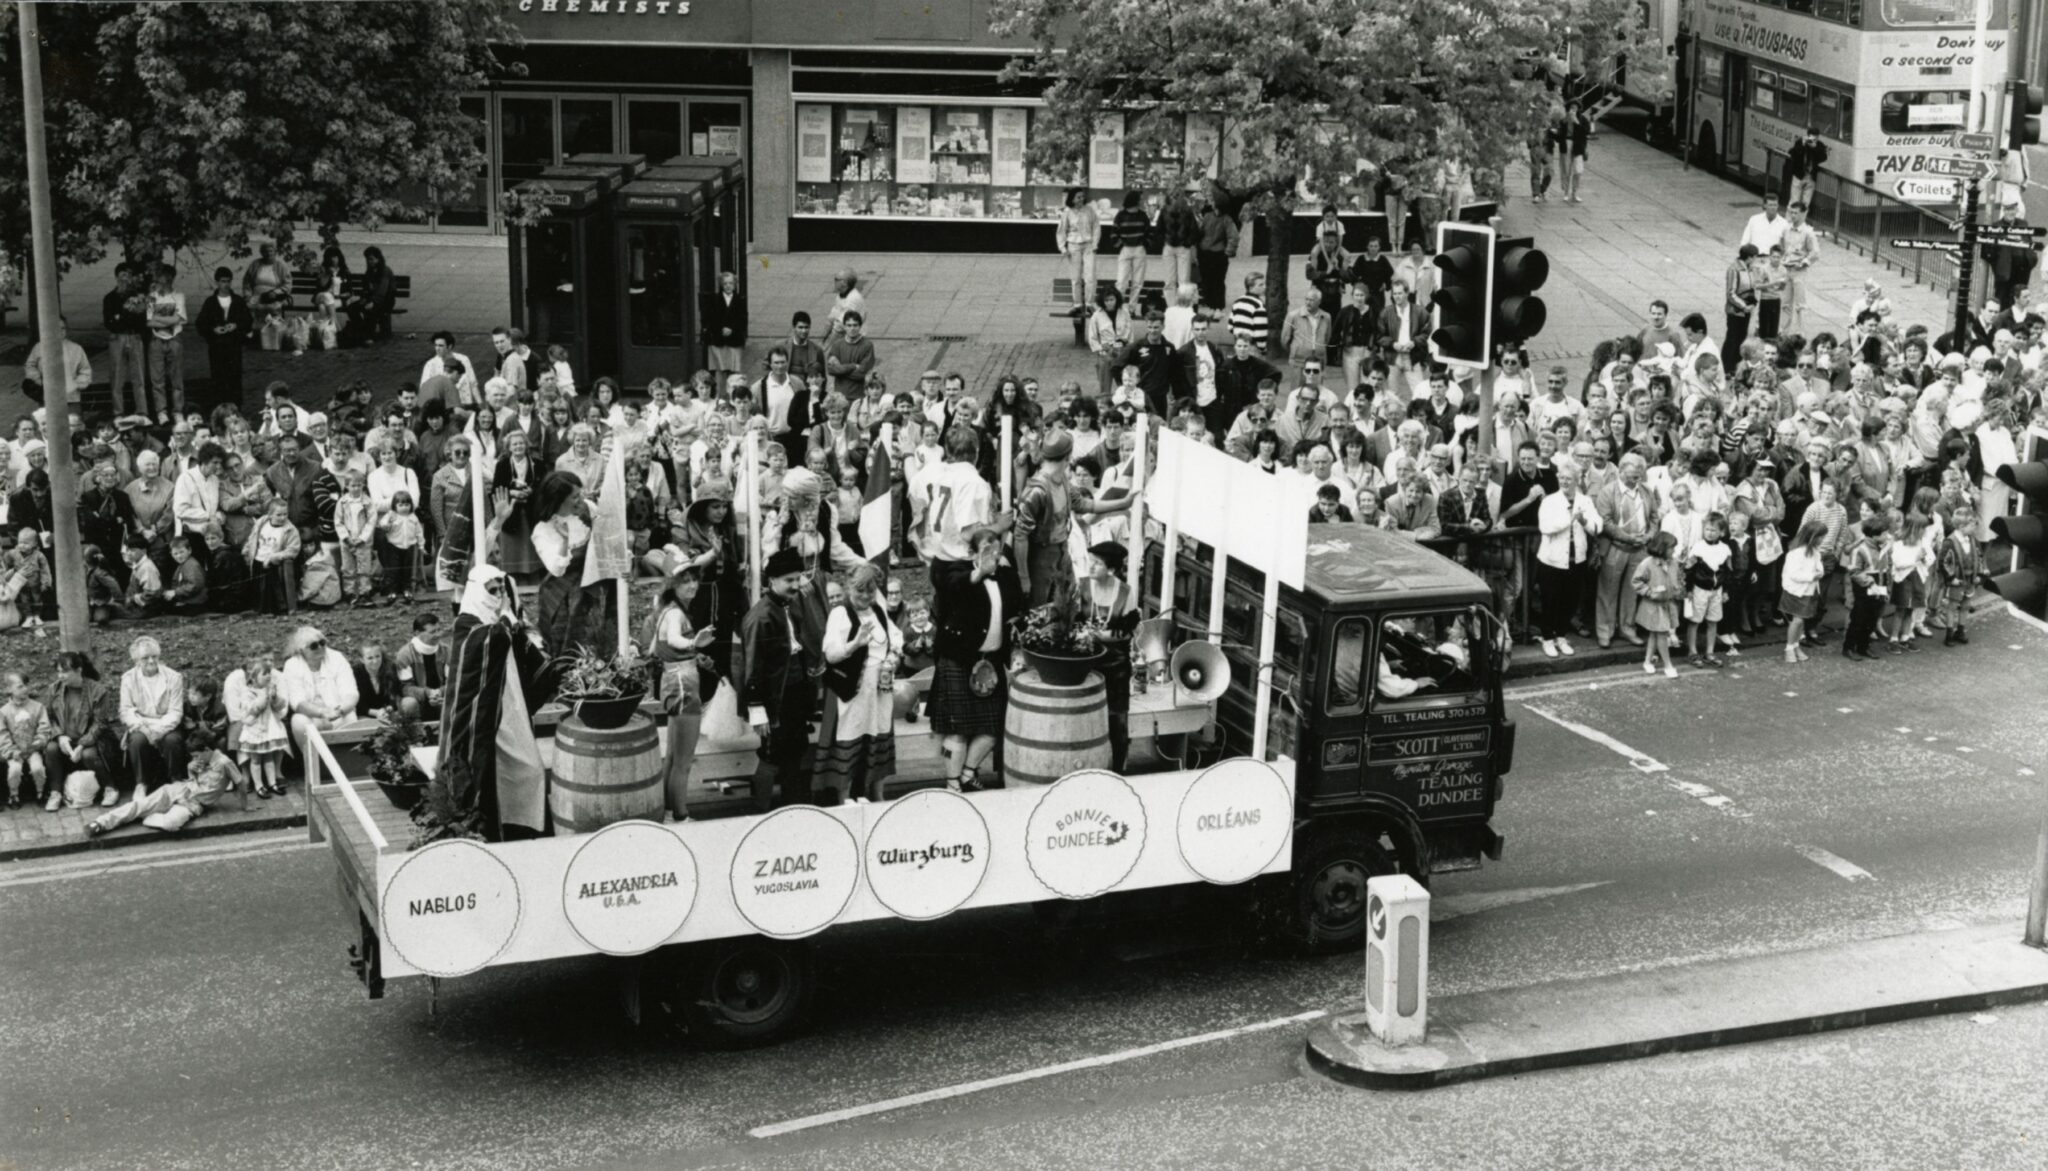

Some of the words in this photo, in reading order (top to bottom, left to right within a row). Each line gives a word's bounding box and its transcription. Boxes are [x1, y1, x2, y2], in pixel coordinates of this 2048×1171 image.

[519, 0, 690, 14] CHEMISTS
[1714, 22, 1731, 40] use
[1733, 28, 1740, 42] a
[1741, 23, 1808, 60] TAYBUSPASS
[1937, 36, 1975, 49] Don't
[1985, 40, 2006, 52] uy
[1881, 56, 1894, 66] a
[1898, 53, 1957, 66] second
[1886, 136, 1925, 146] better
[1909, 183, 1952, 195] Toilets
[924, 483, 951, 533] 17
[1404, 710, 1445, 722] TEALING
[1395, 736, 1440, 756] SCOTT
[1417, 772, 1483, 790] TEALING
[1418, 788, 1483, 807] DUNDEE
[1056, 808, 1111, 831] BONNIE
[1197, 806, 1261, 832] ORLÉANS
[1047, 830, 1105, 849] DUNDEE
[877, 840, 974, 869] Würzburg
[753, 852, 818, 878] ZADAR
[578, 871, 678, 899] ALEXANDRIA
[754, 878, 819, 895] YUGOSLAVIA
[409, 892, 476, 916] NABLOS
